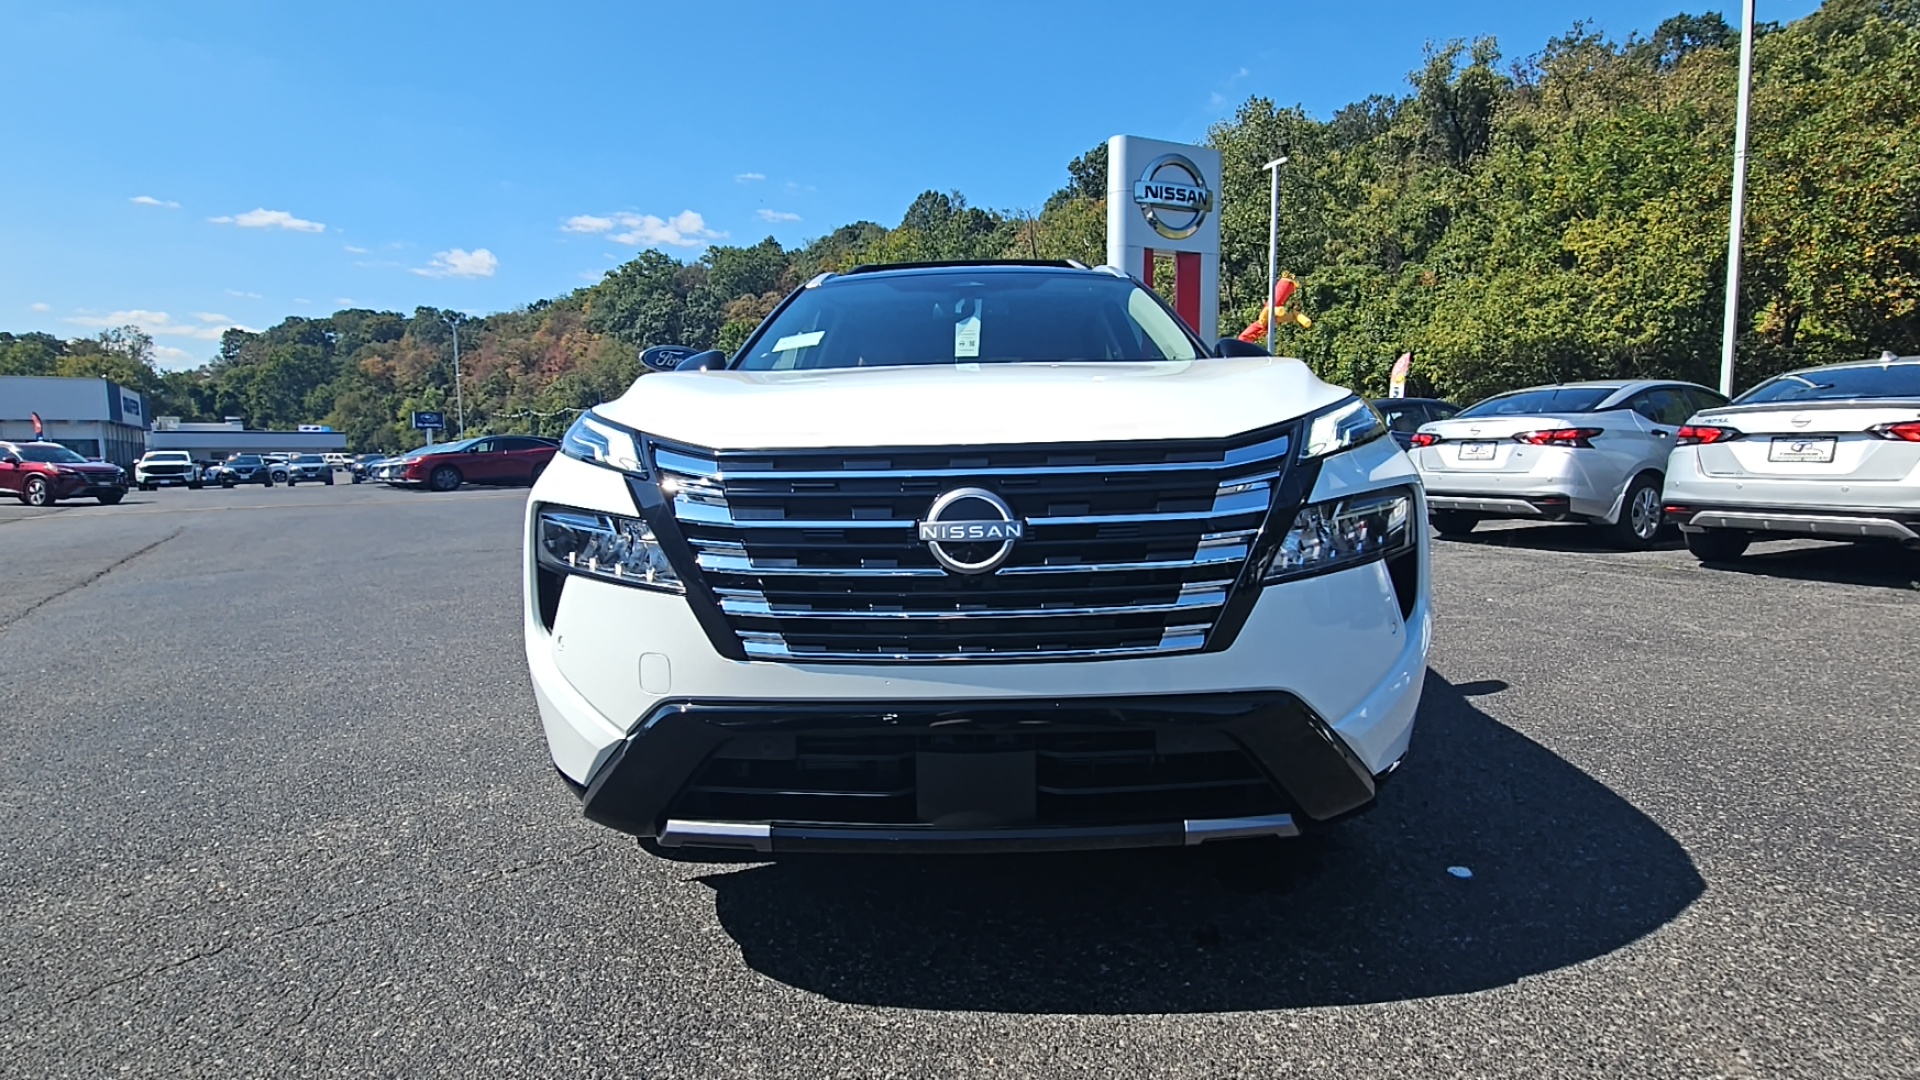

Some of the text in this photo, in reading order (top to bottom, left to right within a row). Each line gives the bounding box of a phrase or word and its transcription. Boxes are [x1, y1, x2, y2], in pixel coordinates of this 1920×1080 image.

[1145, 185, 1208, 206] NISSAN
[655, 350, 685, 367] For
[922, 524, 1021, 539] NISSAN
